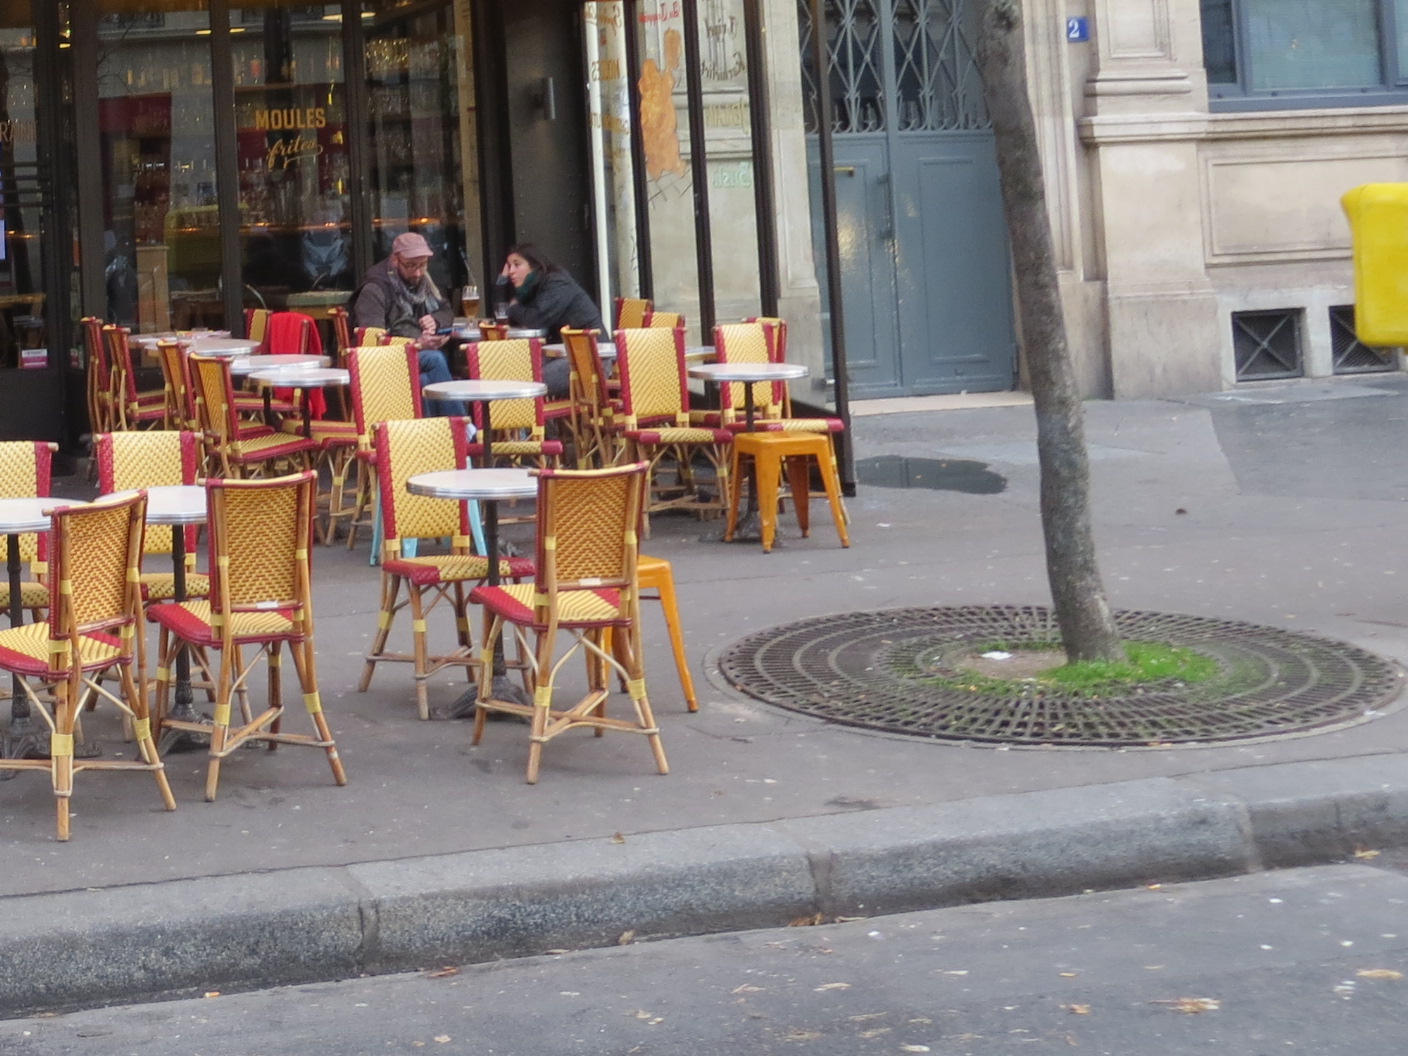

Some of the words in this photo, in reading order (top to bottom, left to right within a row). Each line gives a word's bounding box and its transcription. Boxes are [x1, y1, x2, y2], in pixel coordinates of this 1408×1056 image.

[1068, 20, 1079, 39] 2
[255, 107, 326, 130] MOULES
[266, 134, 324, 172] frites
